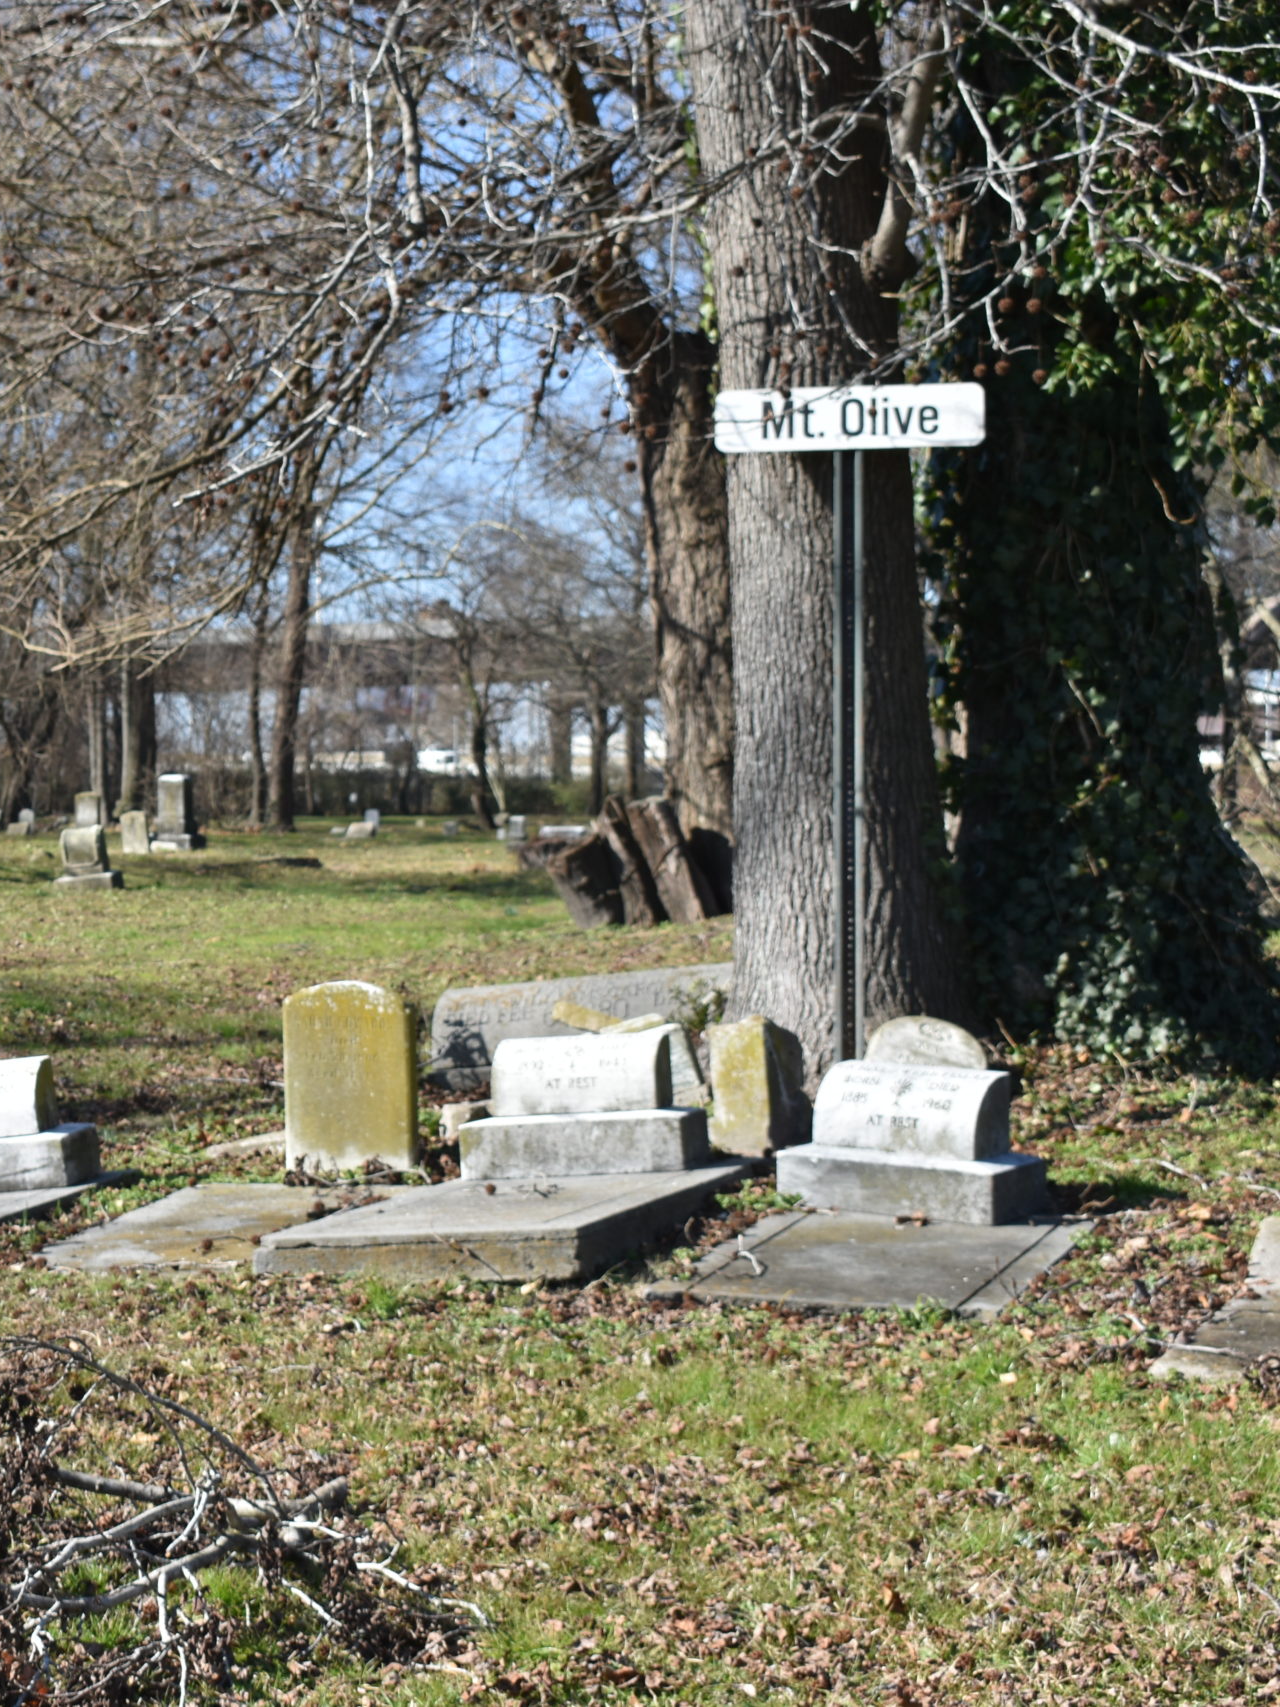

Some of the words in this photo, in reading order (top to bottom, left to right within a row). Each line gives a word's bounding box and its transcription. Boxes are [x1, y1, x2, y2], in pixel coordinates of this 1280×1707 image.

[762, 400, 824, 439] Mt.
[841, 397, 939, 437] Olive
[865, 1114, 884, 1126] AT
